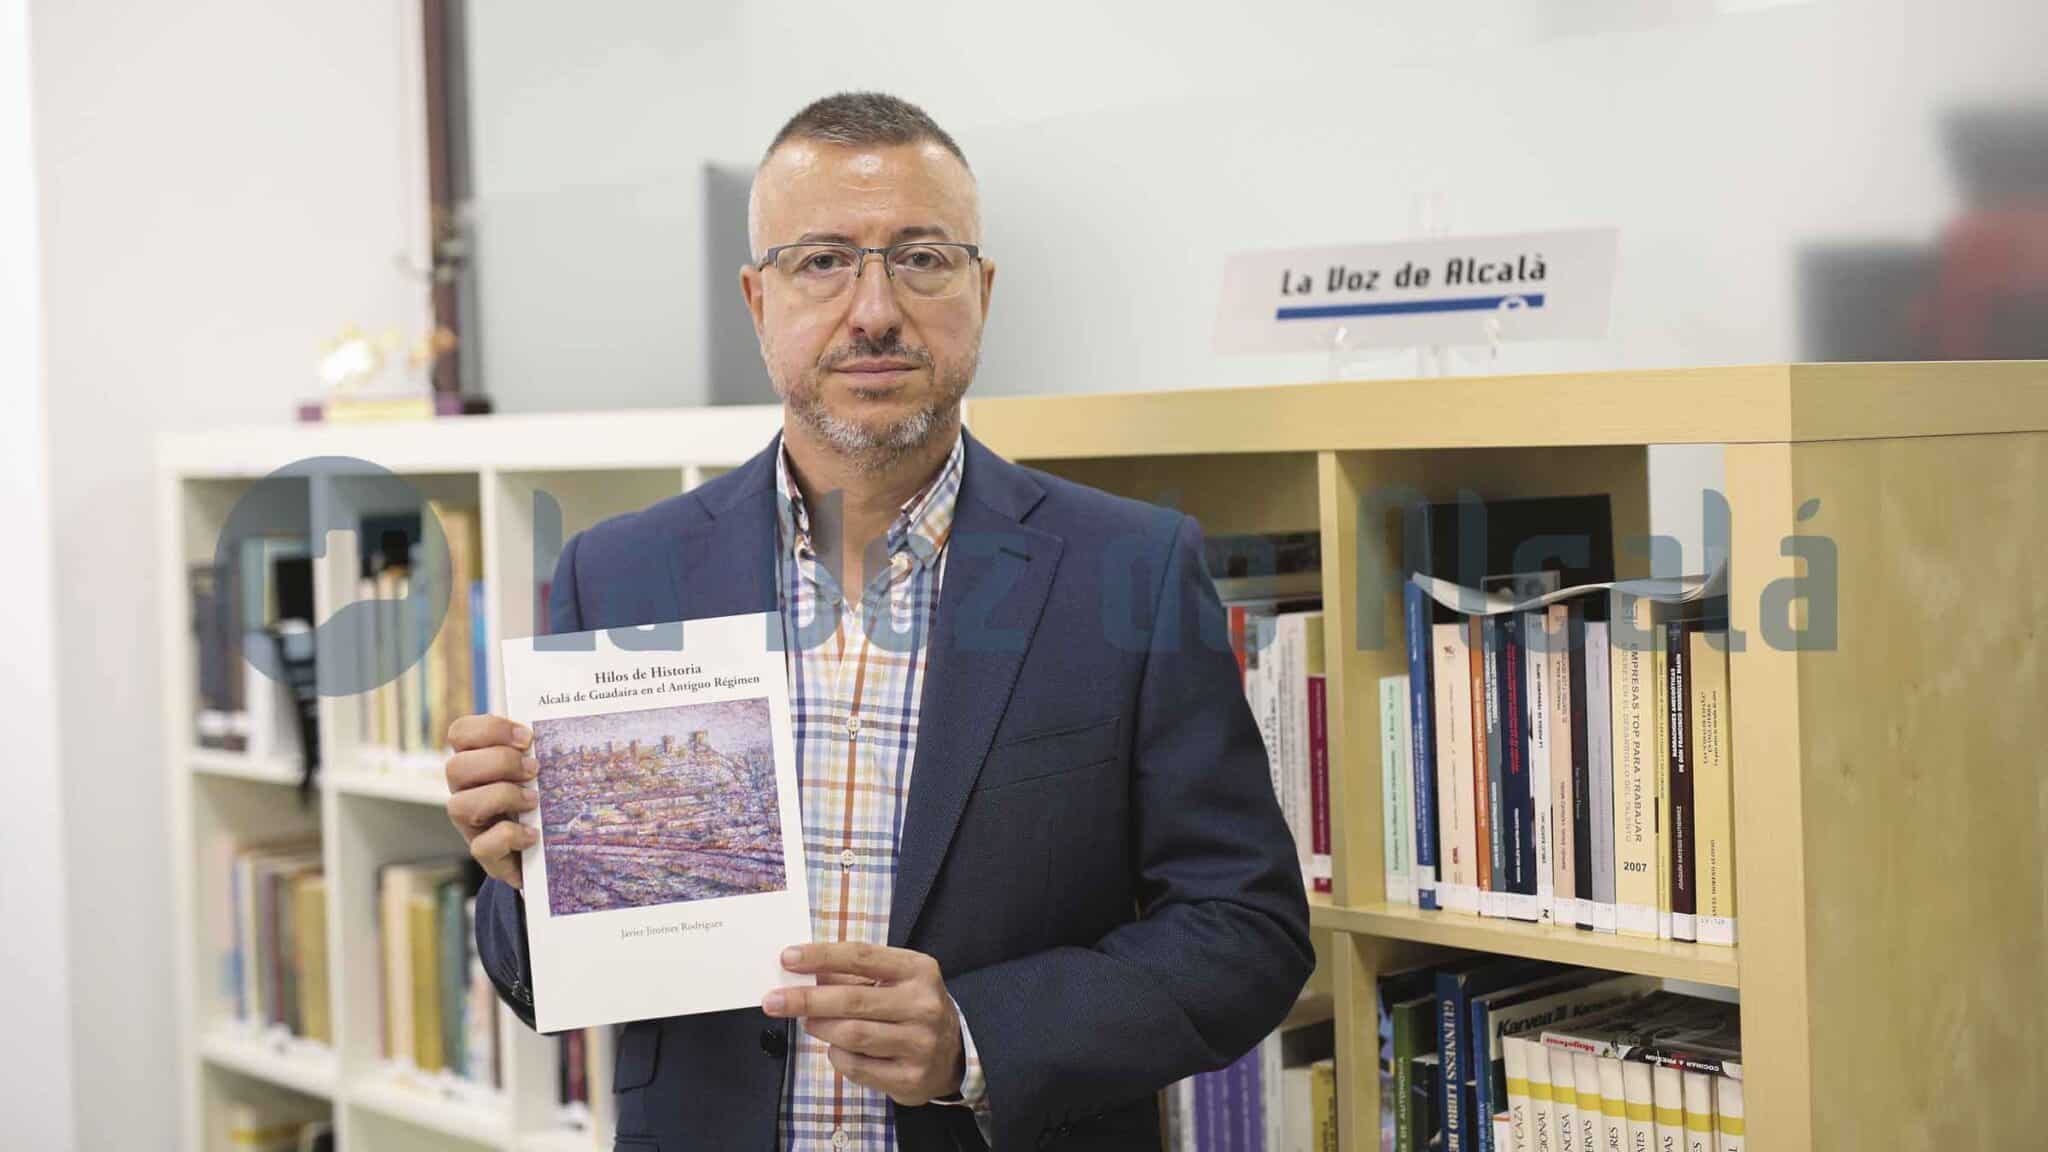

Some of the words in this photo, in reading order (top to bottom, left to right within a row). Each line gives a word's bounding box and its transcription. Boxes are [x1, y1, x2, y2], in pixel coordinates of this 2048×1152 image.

[1281, 269, 1312, 295] La
[1327, 265, 1379, 292] Voz
[1394, 262, 1430, 288] de
[538, 692, 570, 706] Alcalá
[574, 690, 586, 702] de
[641, 686, 654, 696] en
[656, 683, 666, 694] el
[668, 679, 711, 693] Antiguo
[714, 674, 760, 688] Régimen
[594, 670, 629, 685] Hilos
[632, 668, 647, 680] de
[650, 664, 702, 679] Historia
[1630, 643, 1640, 711] EMPRESAS
[1632, 714, 1641, 738] TOP
[1632, 741, 1641, 774] PARA
[1633, 778, 1642, 843] TRABAJAR
[1623, 861, 1647, 873] 2007
[1443, 1000, 1457, 1080] GUINNESS
[1446, 1083, 1458, 1129] LIBRO
[1513, 1104, 1524, 1140] CAZA
